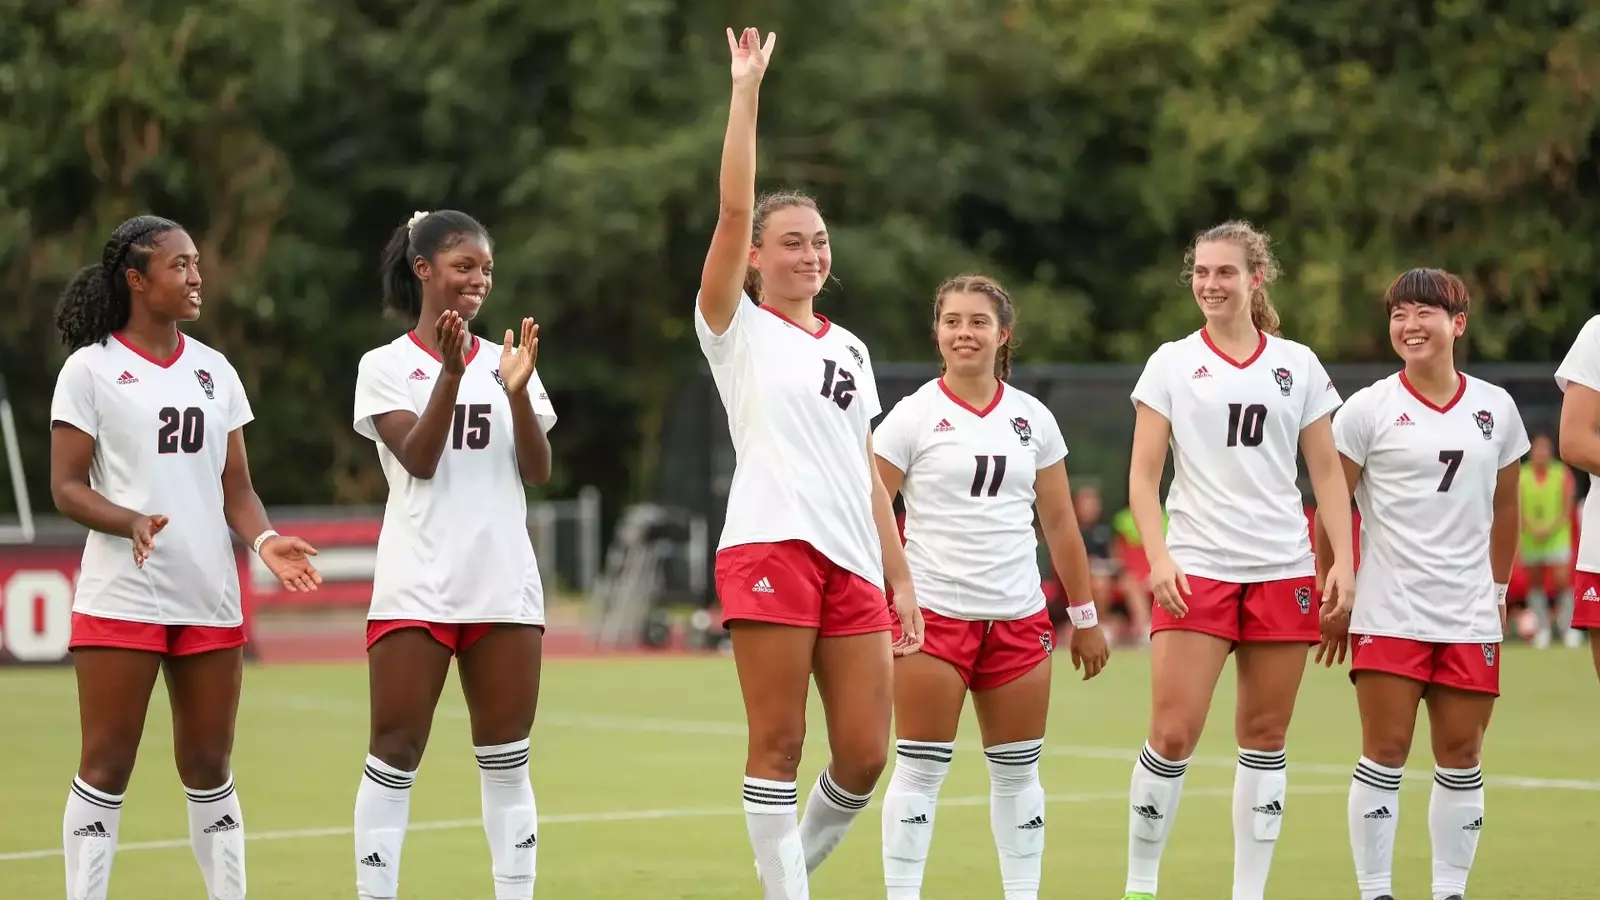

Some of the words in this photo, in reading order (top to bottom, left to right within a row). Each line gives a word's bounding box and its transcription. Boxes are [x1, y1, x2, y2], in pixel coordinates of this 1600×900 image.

[820, 358, 857, 411] 12
[157, 407, 205, 454] 20
[452, 403, 491, 450] 15
[1227, 403, 1268, 447] 10
[970, 455, 1007, 497] 11
[1436, 450, 1465, 492] 7
[73, 829, 111, 838] adidas
[203, 822, 240, 833] adidas
